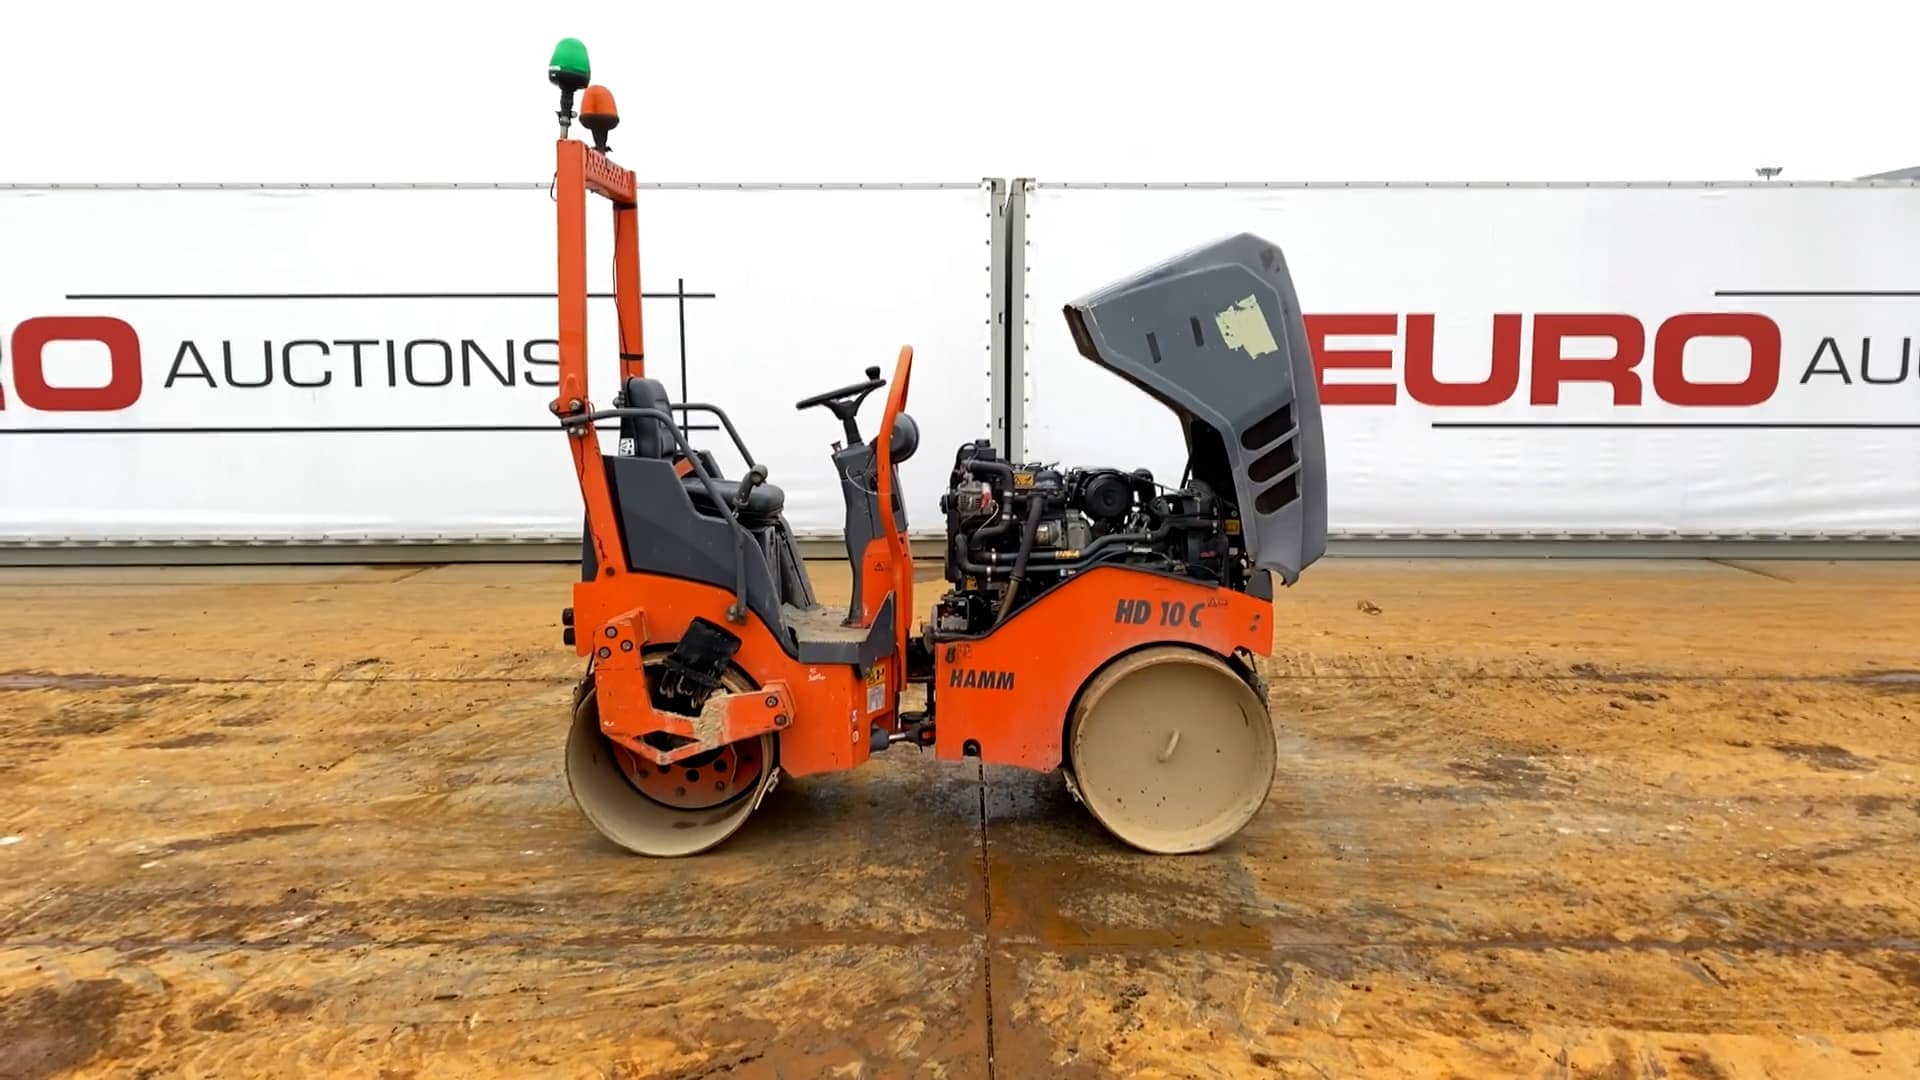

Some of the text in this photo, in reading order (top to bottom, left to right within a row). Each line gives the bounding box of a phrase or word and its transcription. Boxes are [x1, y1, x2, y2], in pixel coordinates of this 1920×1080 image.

[0, 316, 559, 411] O AUCTIONS
[1302, 313, 1920, 406] EURO AU
[1115, 599, 1205, 628] HD 10 C
[949, 668, 1015, 690] HAMM
